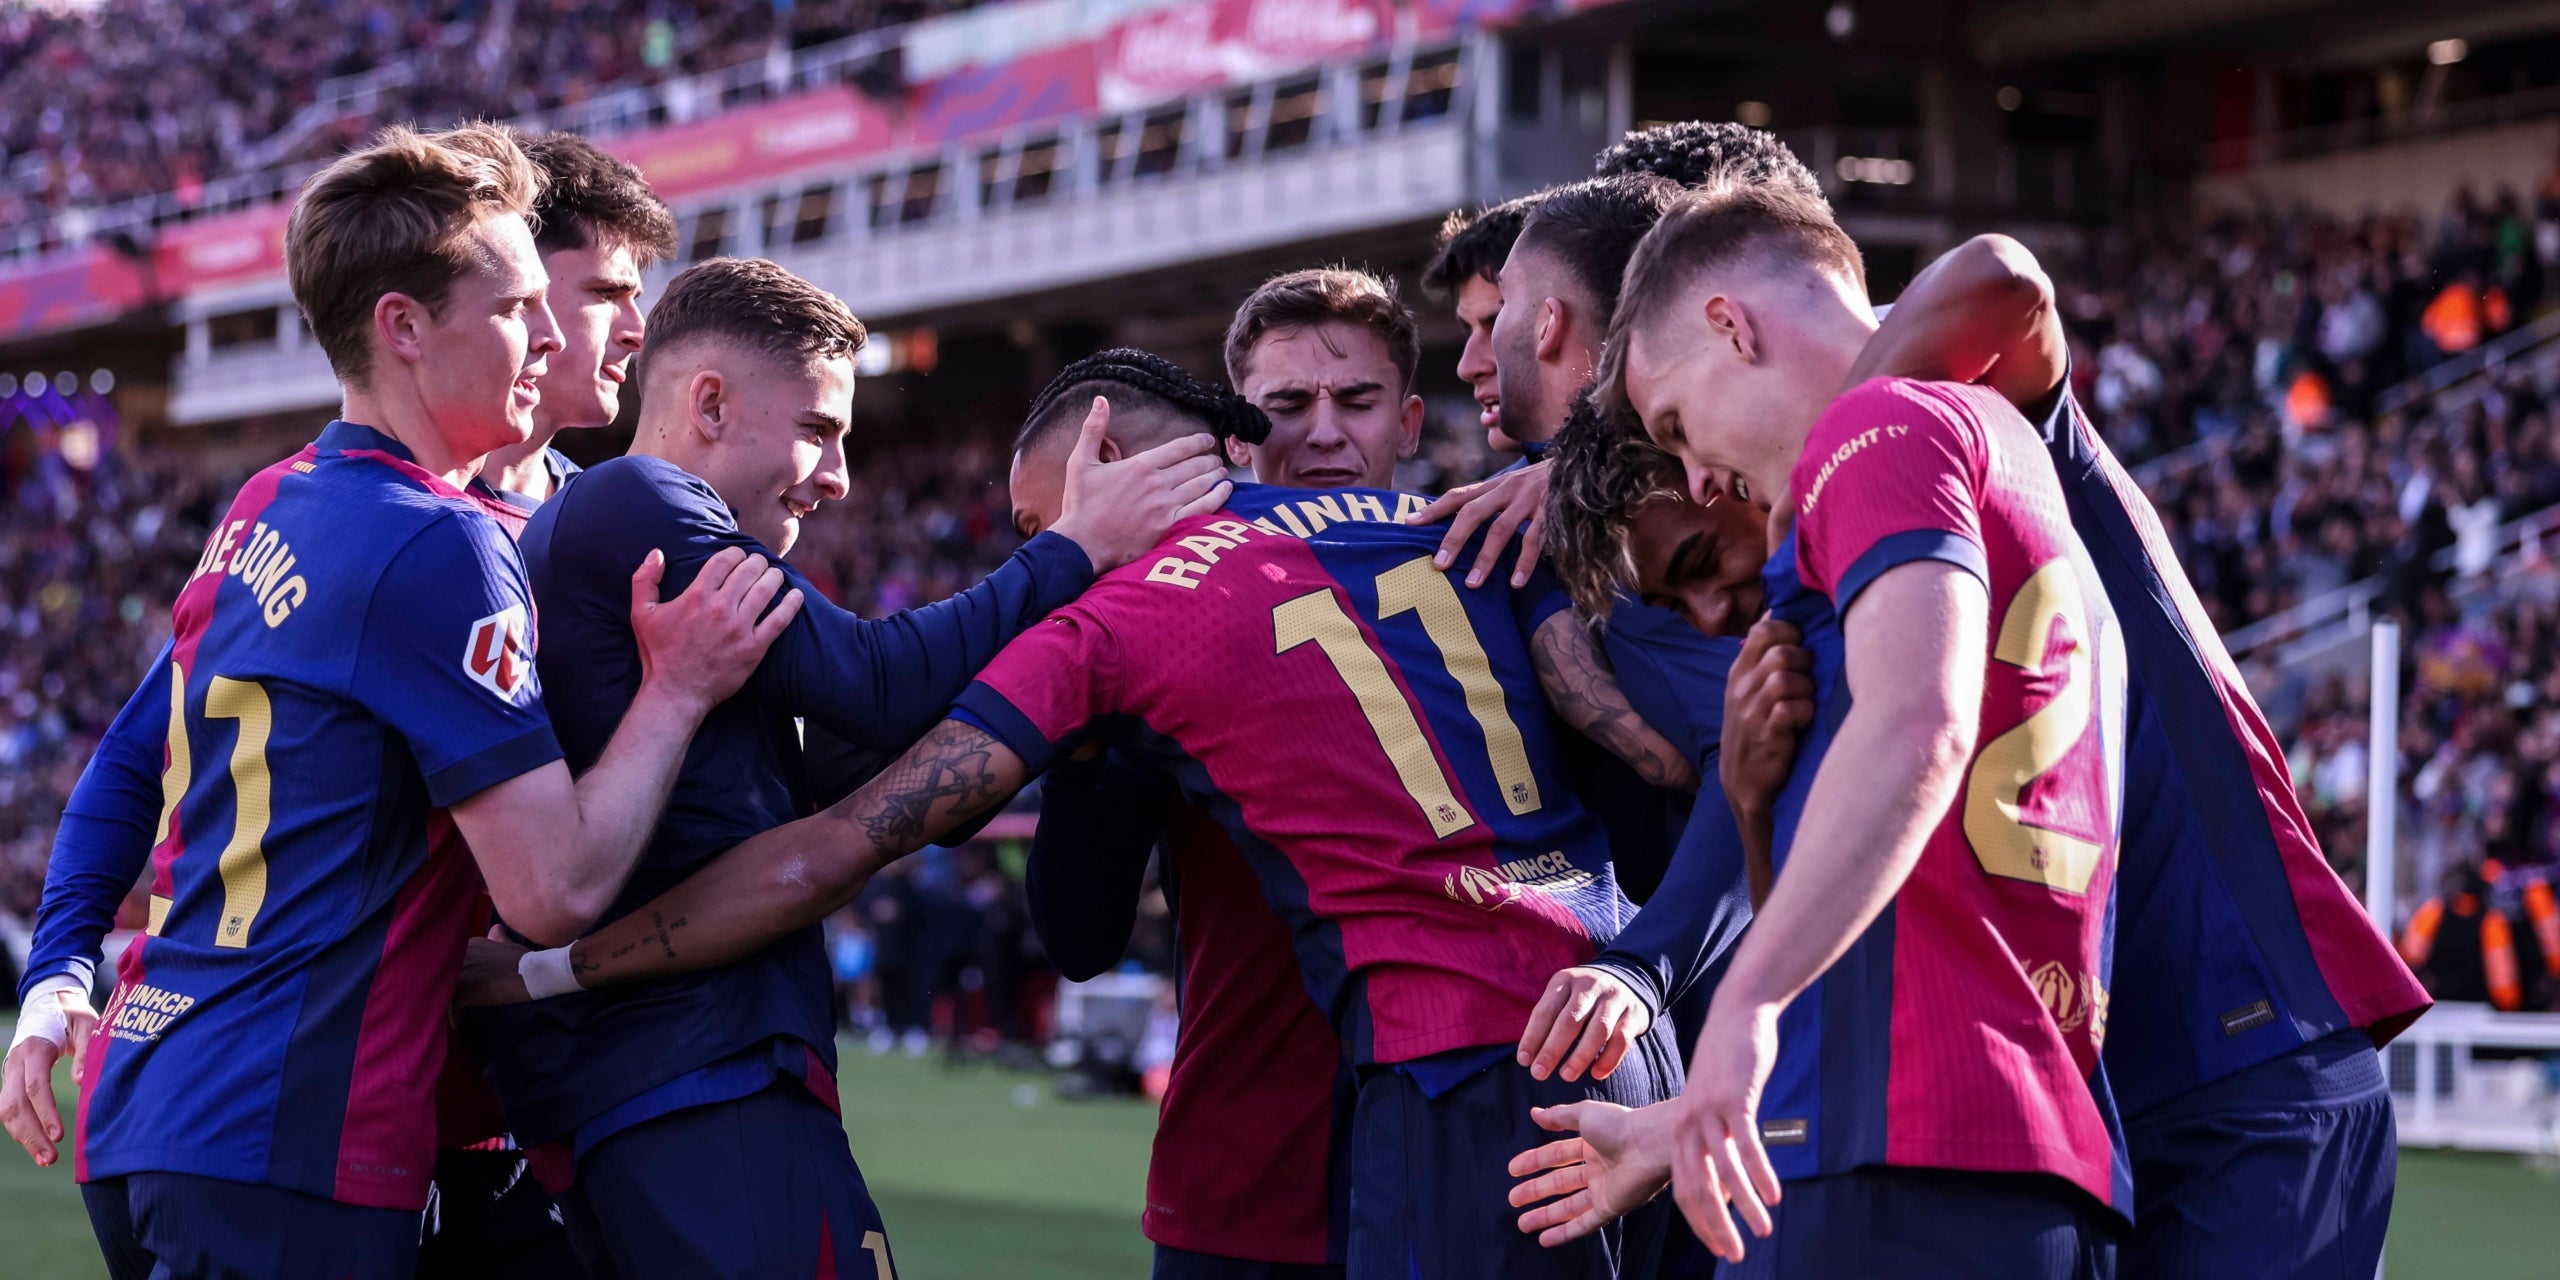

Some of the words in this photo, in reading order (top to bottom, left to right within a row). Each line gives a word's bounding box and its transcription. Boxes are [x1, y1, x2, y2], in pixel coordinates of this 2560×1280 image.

[1886, 424, 1909, 438] tv
[228, 521, 307, 628] JONG
[1266, 553, 1543, 840] 11
[1493, 850, 1574, 884] UNHCR
[125, 984, 195, 1016] UNHCR
